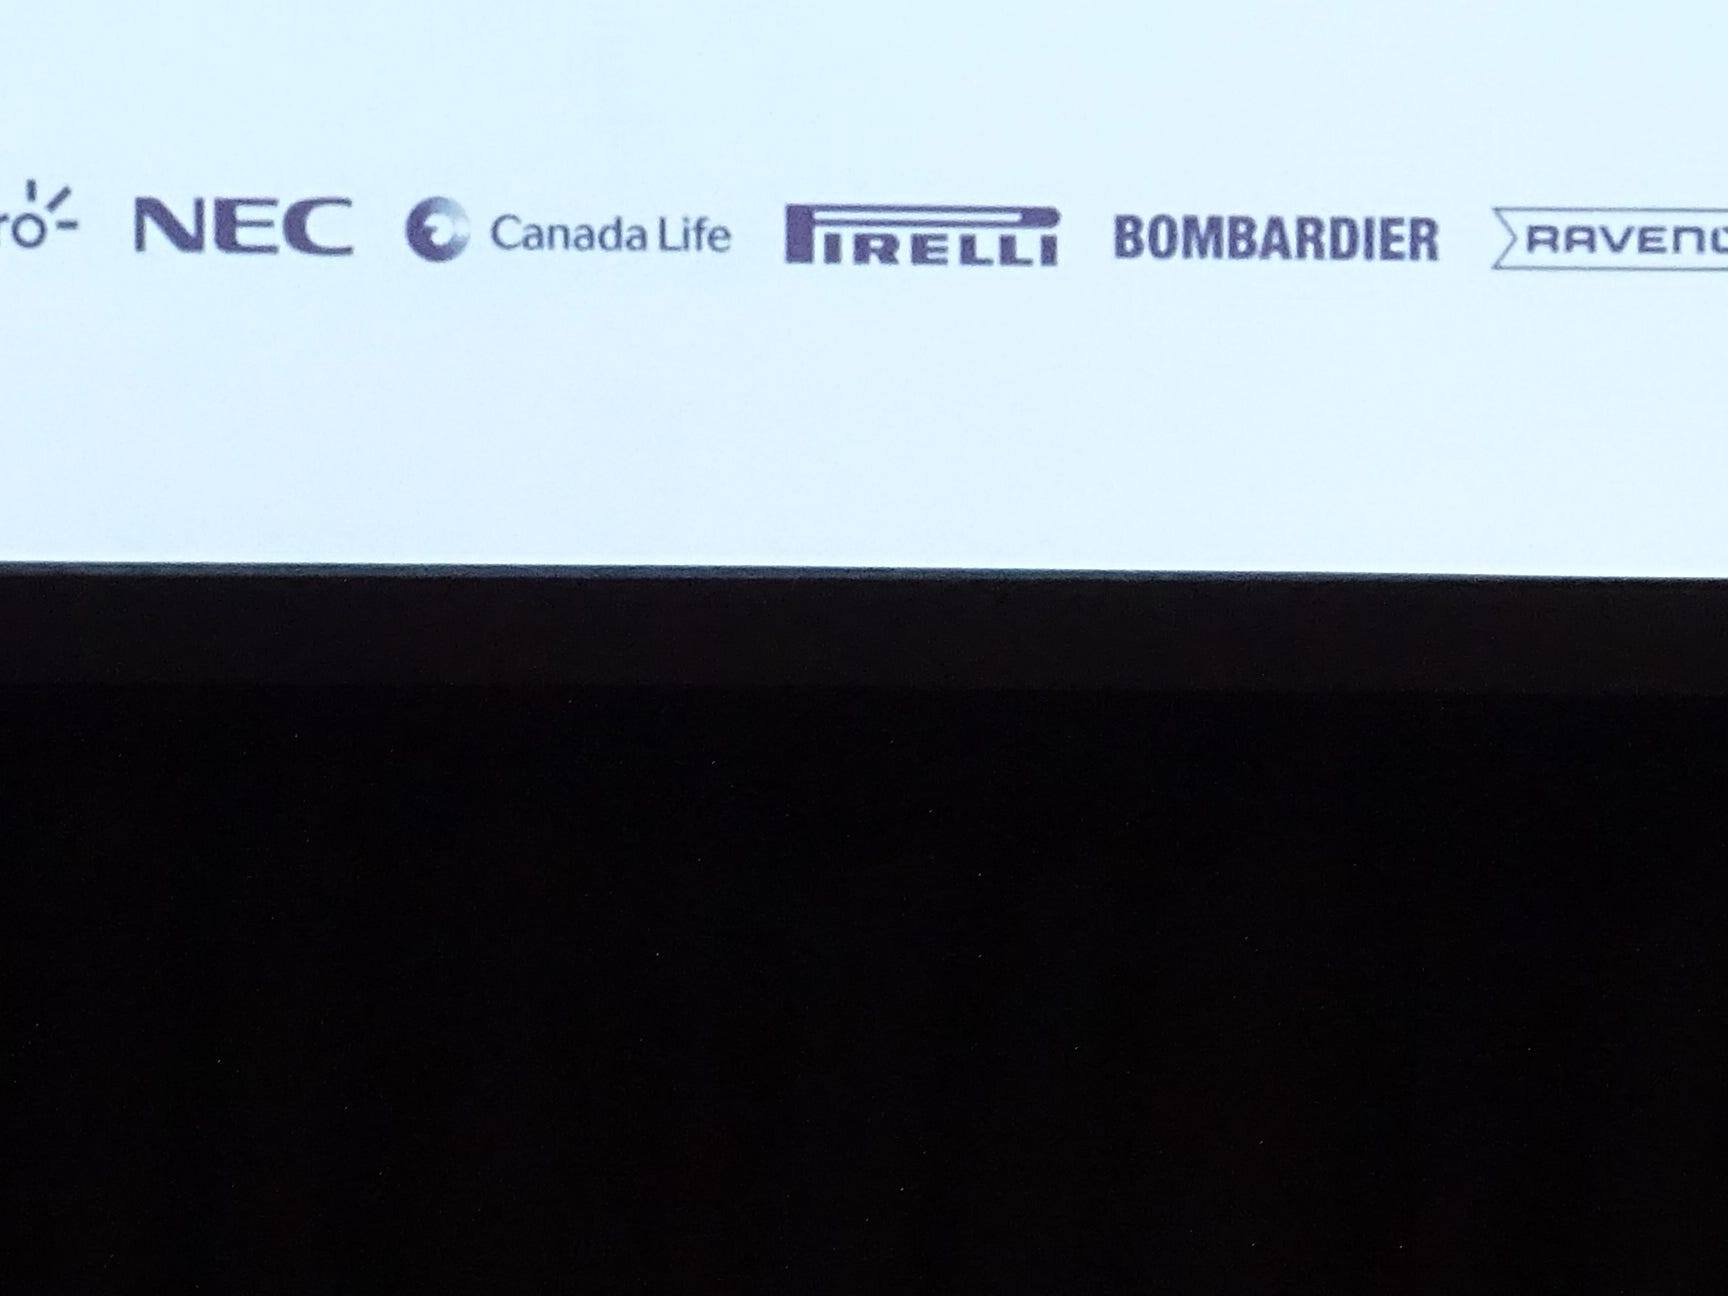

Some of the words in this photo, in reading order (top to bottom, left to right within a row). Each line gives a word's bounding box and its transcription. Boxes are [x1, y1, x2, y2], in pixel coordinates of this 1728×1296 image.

[133, 196, 354, 256] NEC
[491, 214, 648, 253] Canada
[658, 214, 732, 254] Life
[785, 203, 1062, 266] PIRELLI
[1113, 214, 1440, 262] BOMBARDIER
